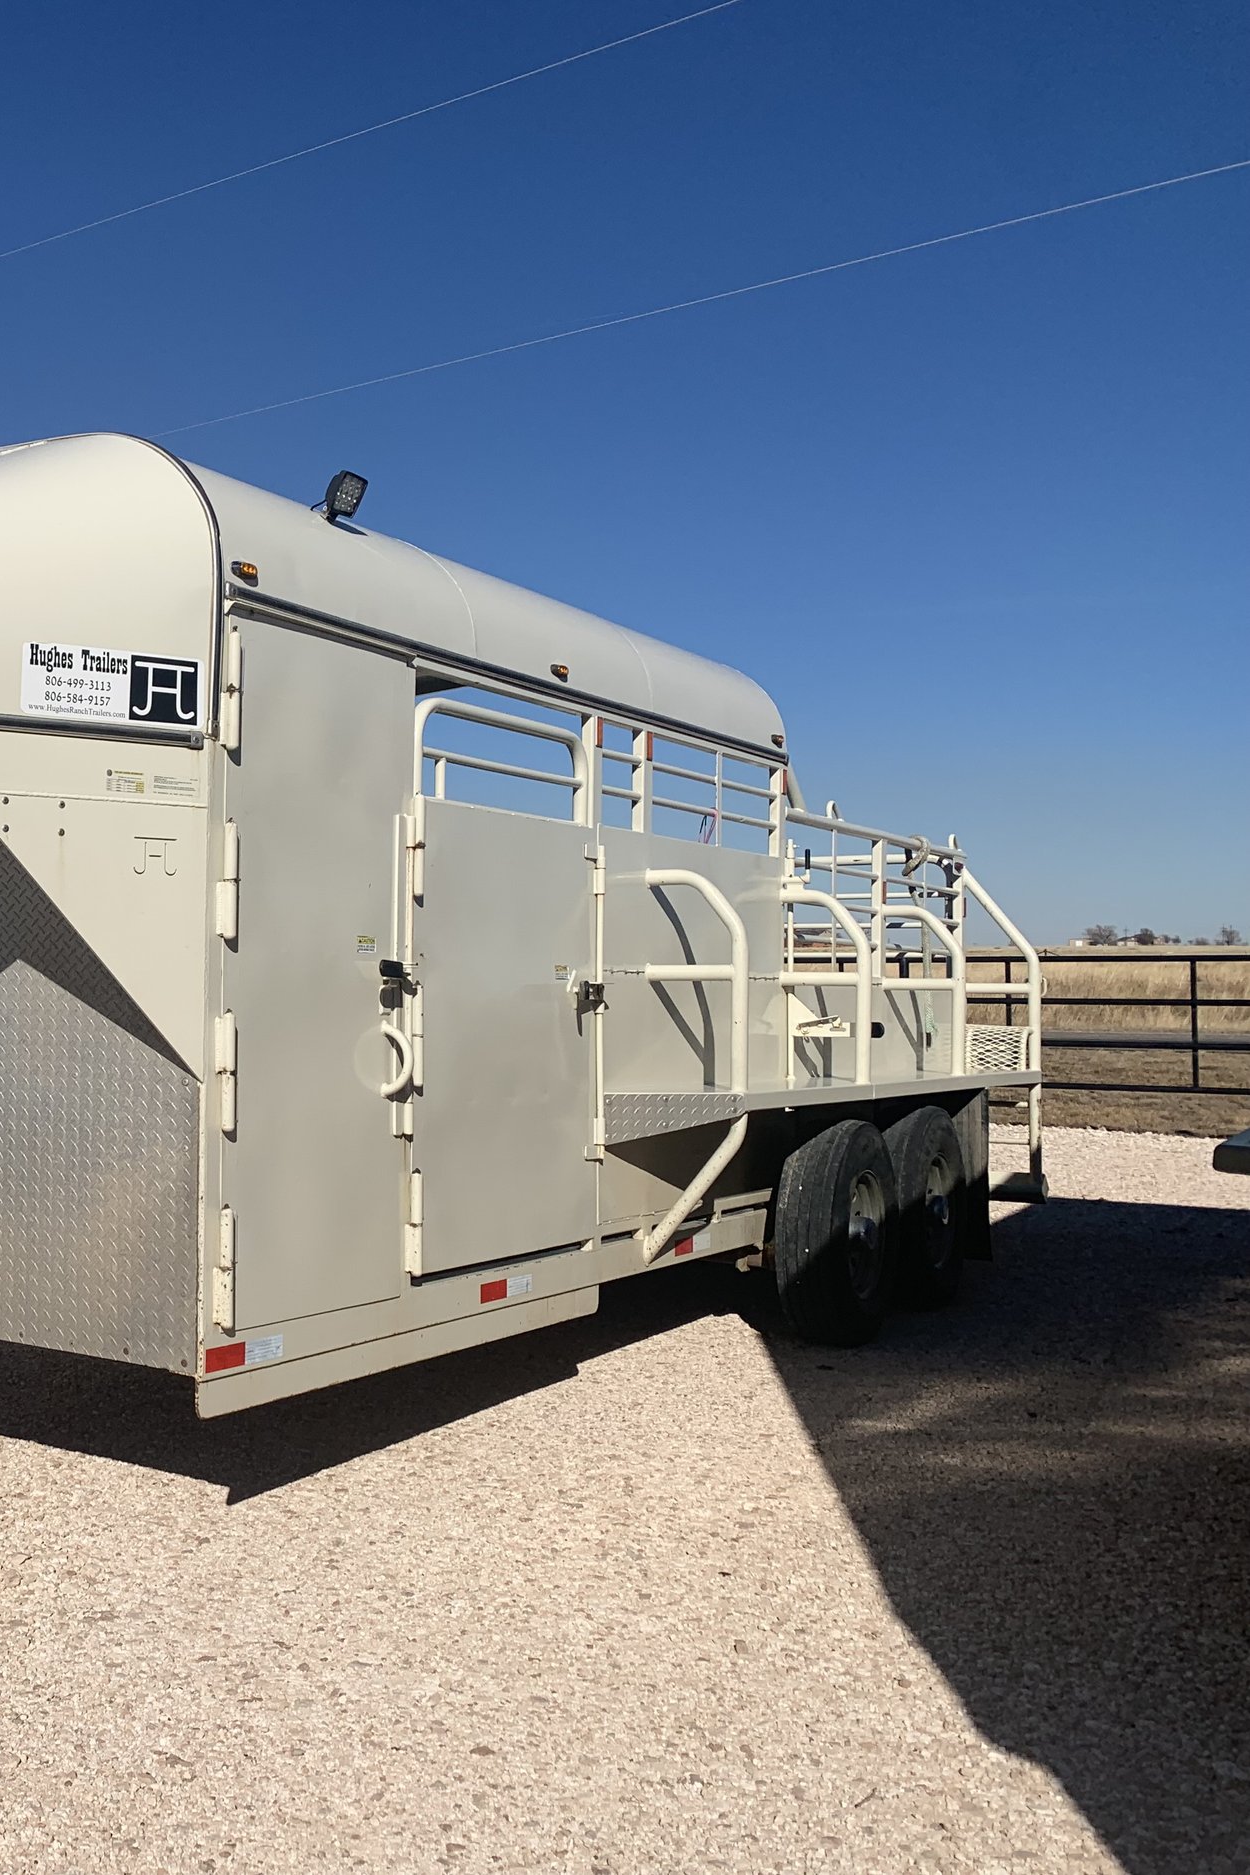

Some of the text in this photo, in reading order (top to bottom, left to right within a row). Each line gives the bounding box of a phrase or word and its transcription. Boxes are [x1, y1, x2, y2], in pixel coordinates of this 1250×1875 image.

[30, 643, 128, 675] Hughes Trailers
[45, 675, 112, 692] 806-499-3113
[44, 691, 111, 706] 806-584-9157
[28, 703, 126, 719] www.HughesRanchTrailers.com
